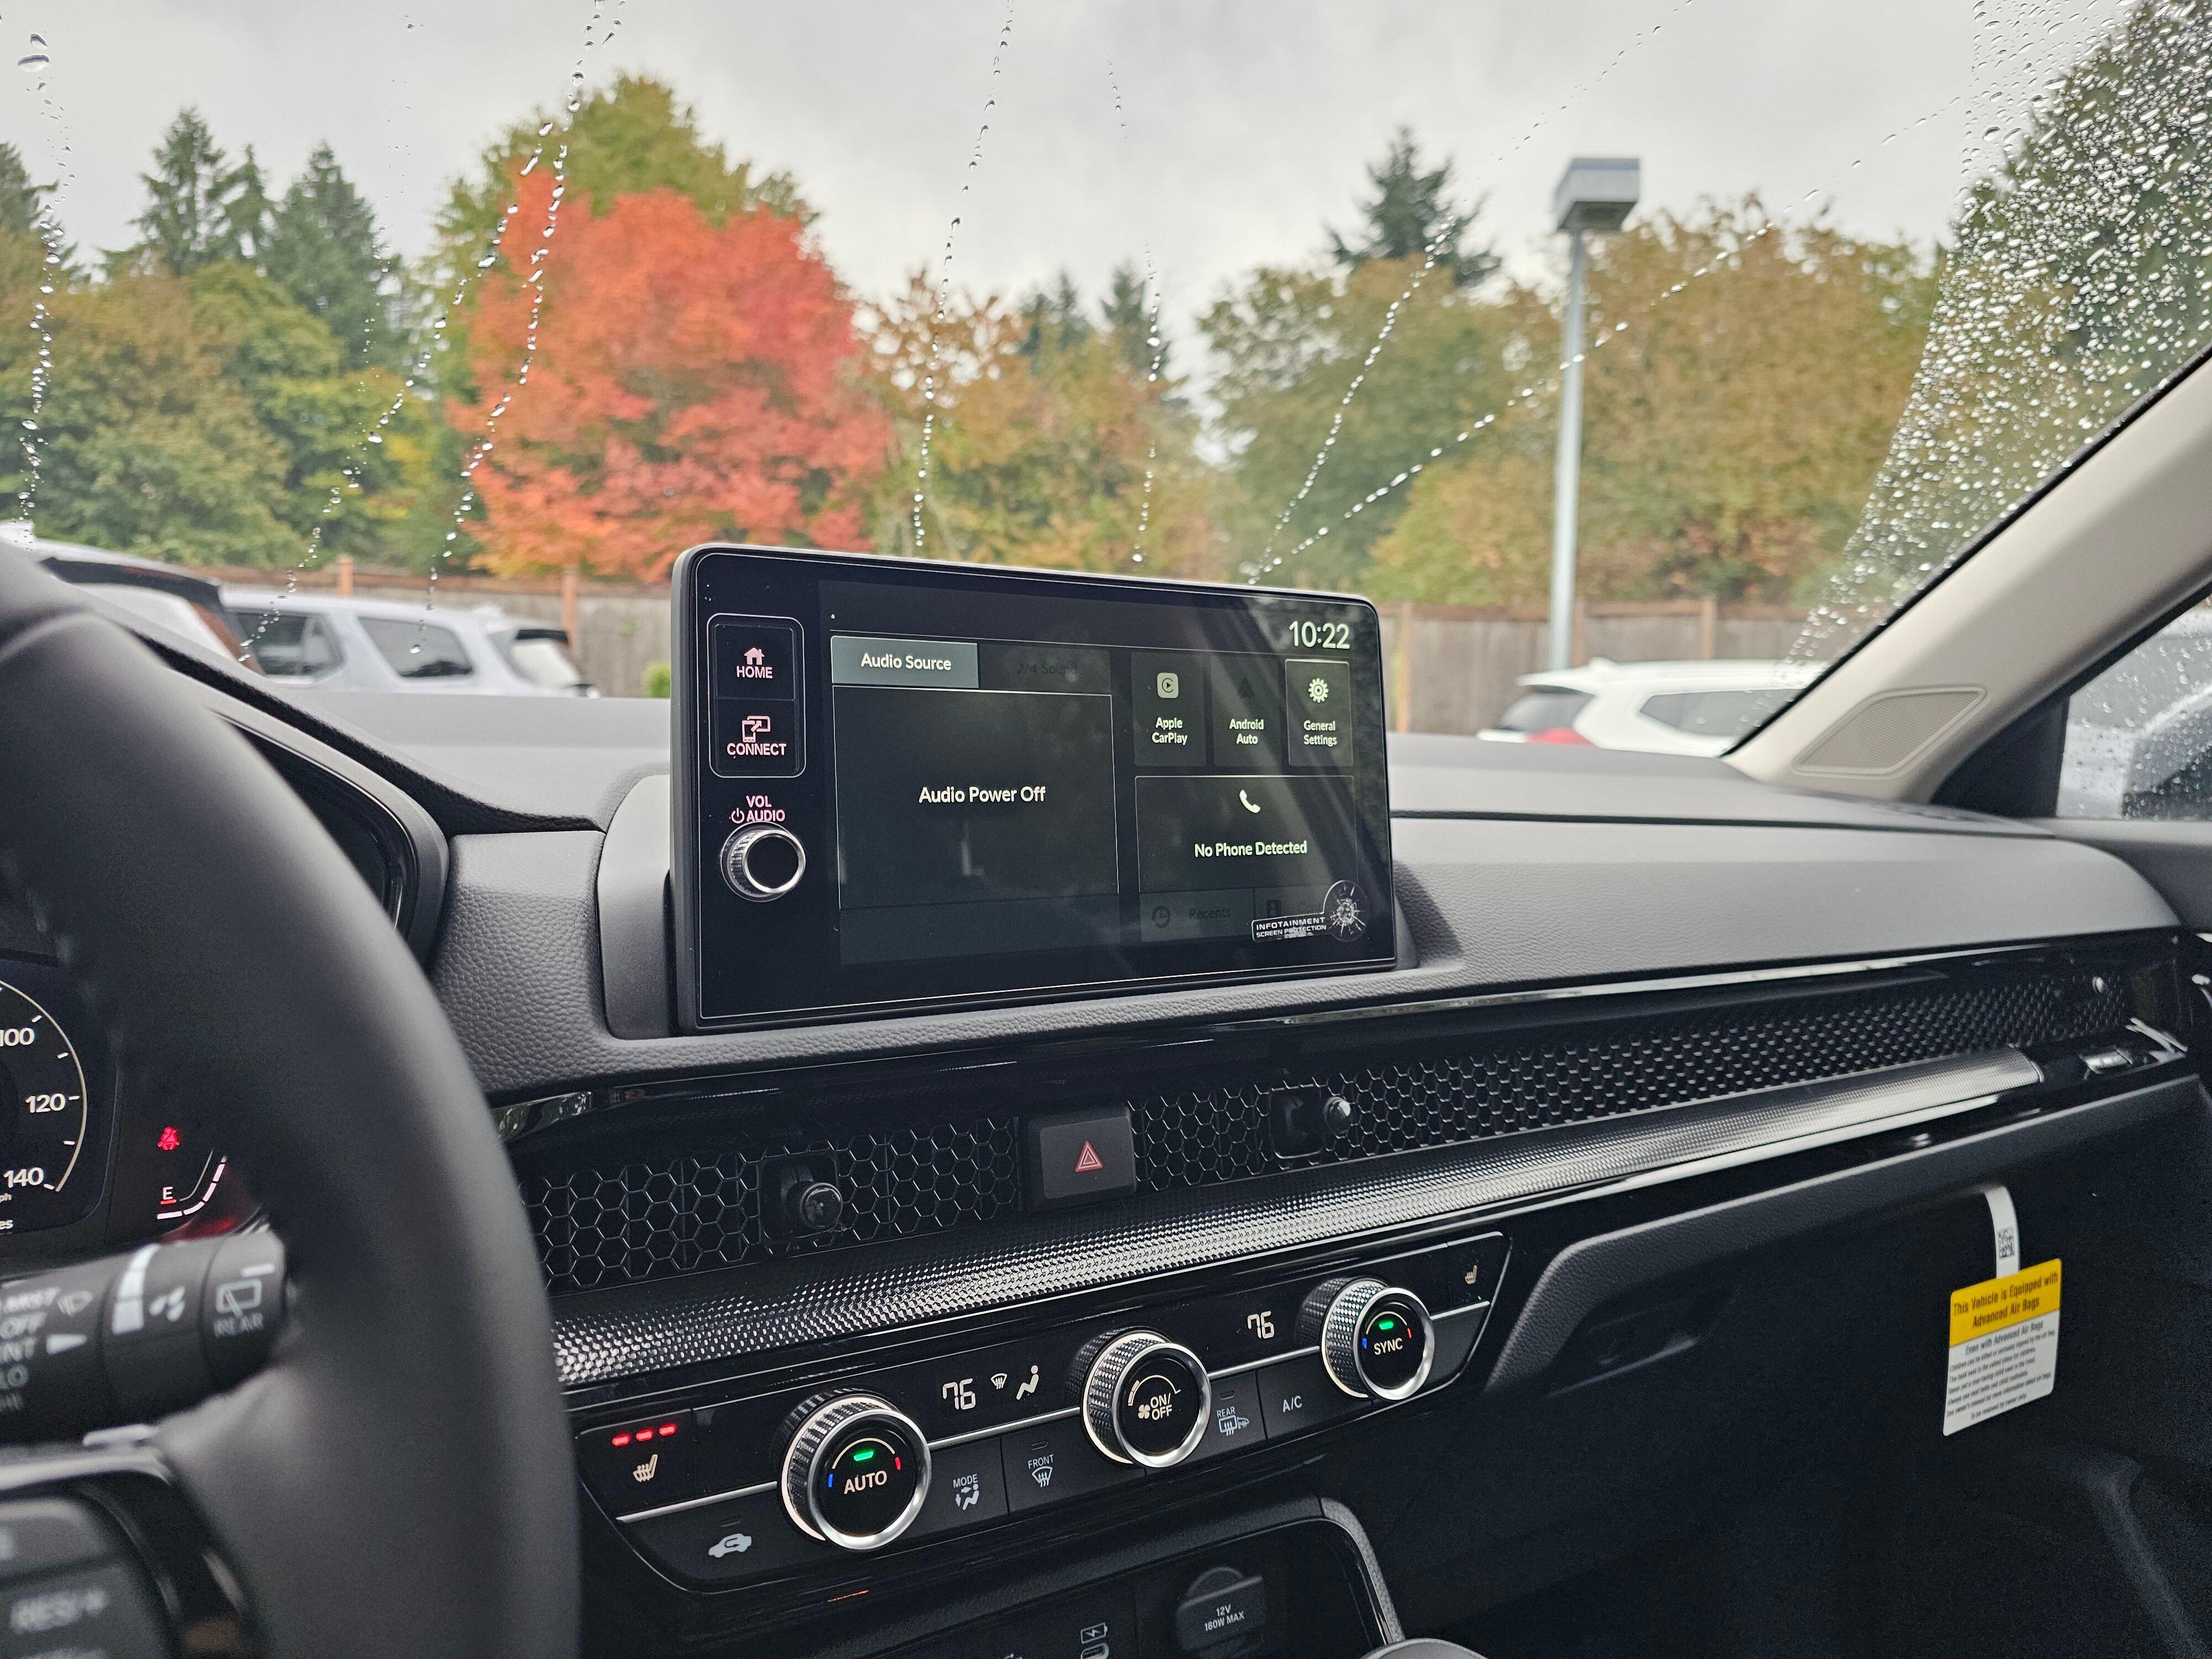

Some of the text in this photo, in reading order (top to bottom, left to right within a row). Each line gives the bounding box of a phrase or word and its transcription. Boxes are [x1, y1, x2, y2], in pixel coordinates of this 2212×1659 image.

[1289, 621, 1350, 649] 10:22
[860, 653, 952, 671] Audio Source
[736, 666, 773, 679] HOME
[1156, 717, 1183, 731] Apple
[1229, 719, 1264, 731] Android
[1303, 720, 1335, 732] General
[1152, 732, 1188, 745] CarPlay
[1236, 733, 1258, 745] Auto
[1303, 734, 1337, 747] Settings
[727, 743, 787, 757] CONNECT
[746, 795, 773, 807] VOL
[919, 786, 1046, 803] Audio Power Off
[747, 810, 785, 822] AUDIO
[1194, 841, 1307, 858] No Phone Detected
[1190, 907, 1232, 919] Recents
[1256, 917, 1326, 931] INFOTAINMENT
[1256, 925, 1327, 938] SCREEN PROTECTION
[25, 1093, 66, 1113] 120
[3, 1167, 44, 1188] 140
[162, 1186, 173, 1200] E
[1954, 1272, 2058, 1316] This Vehicle is Equipped with
[1973, 1296, 2040, 1328] Advanced Air Bags
[1247, 1310, 1275, 1339] 76
[1966, 1343, 1979, 1354] Even
[1981, 1338, 1992, 1349] with
[1994, 1329, 2020, 1344] Advanced
[2031, 1321, 2043, 1332] Bags
[1374, 1338, 1404, 1356] SYNC
[942, 1378, 976, 1410] 76
[1150, 1395, 1171, 1410] ON/
[1282, 1395, 1303, 1413] A/C
[1151, 1404, 1173, 1421] OFF
[1217, 1406, 1236, 1418] REAR
[1027, 1454, 1055, 1469] FRONT
[843, 1470, 888, 1495] AUTO
[952, 1474, 979, 1489] MODE
[1216, 1604, 1231, 1616] 12V
[1204, 1611, 1244, 1631] 180W MAX
